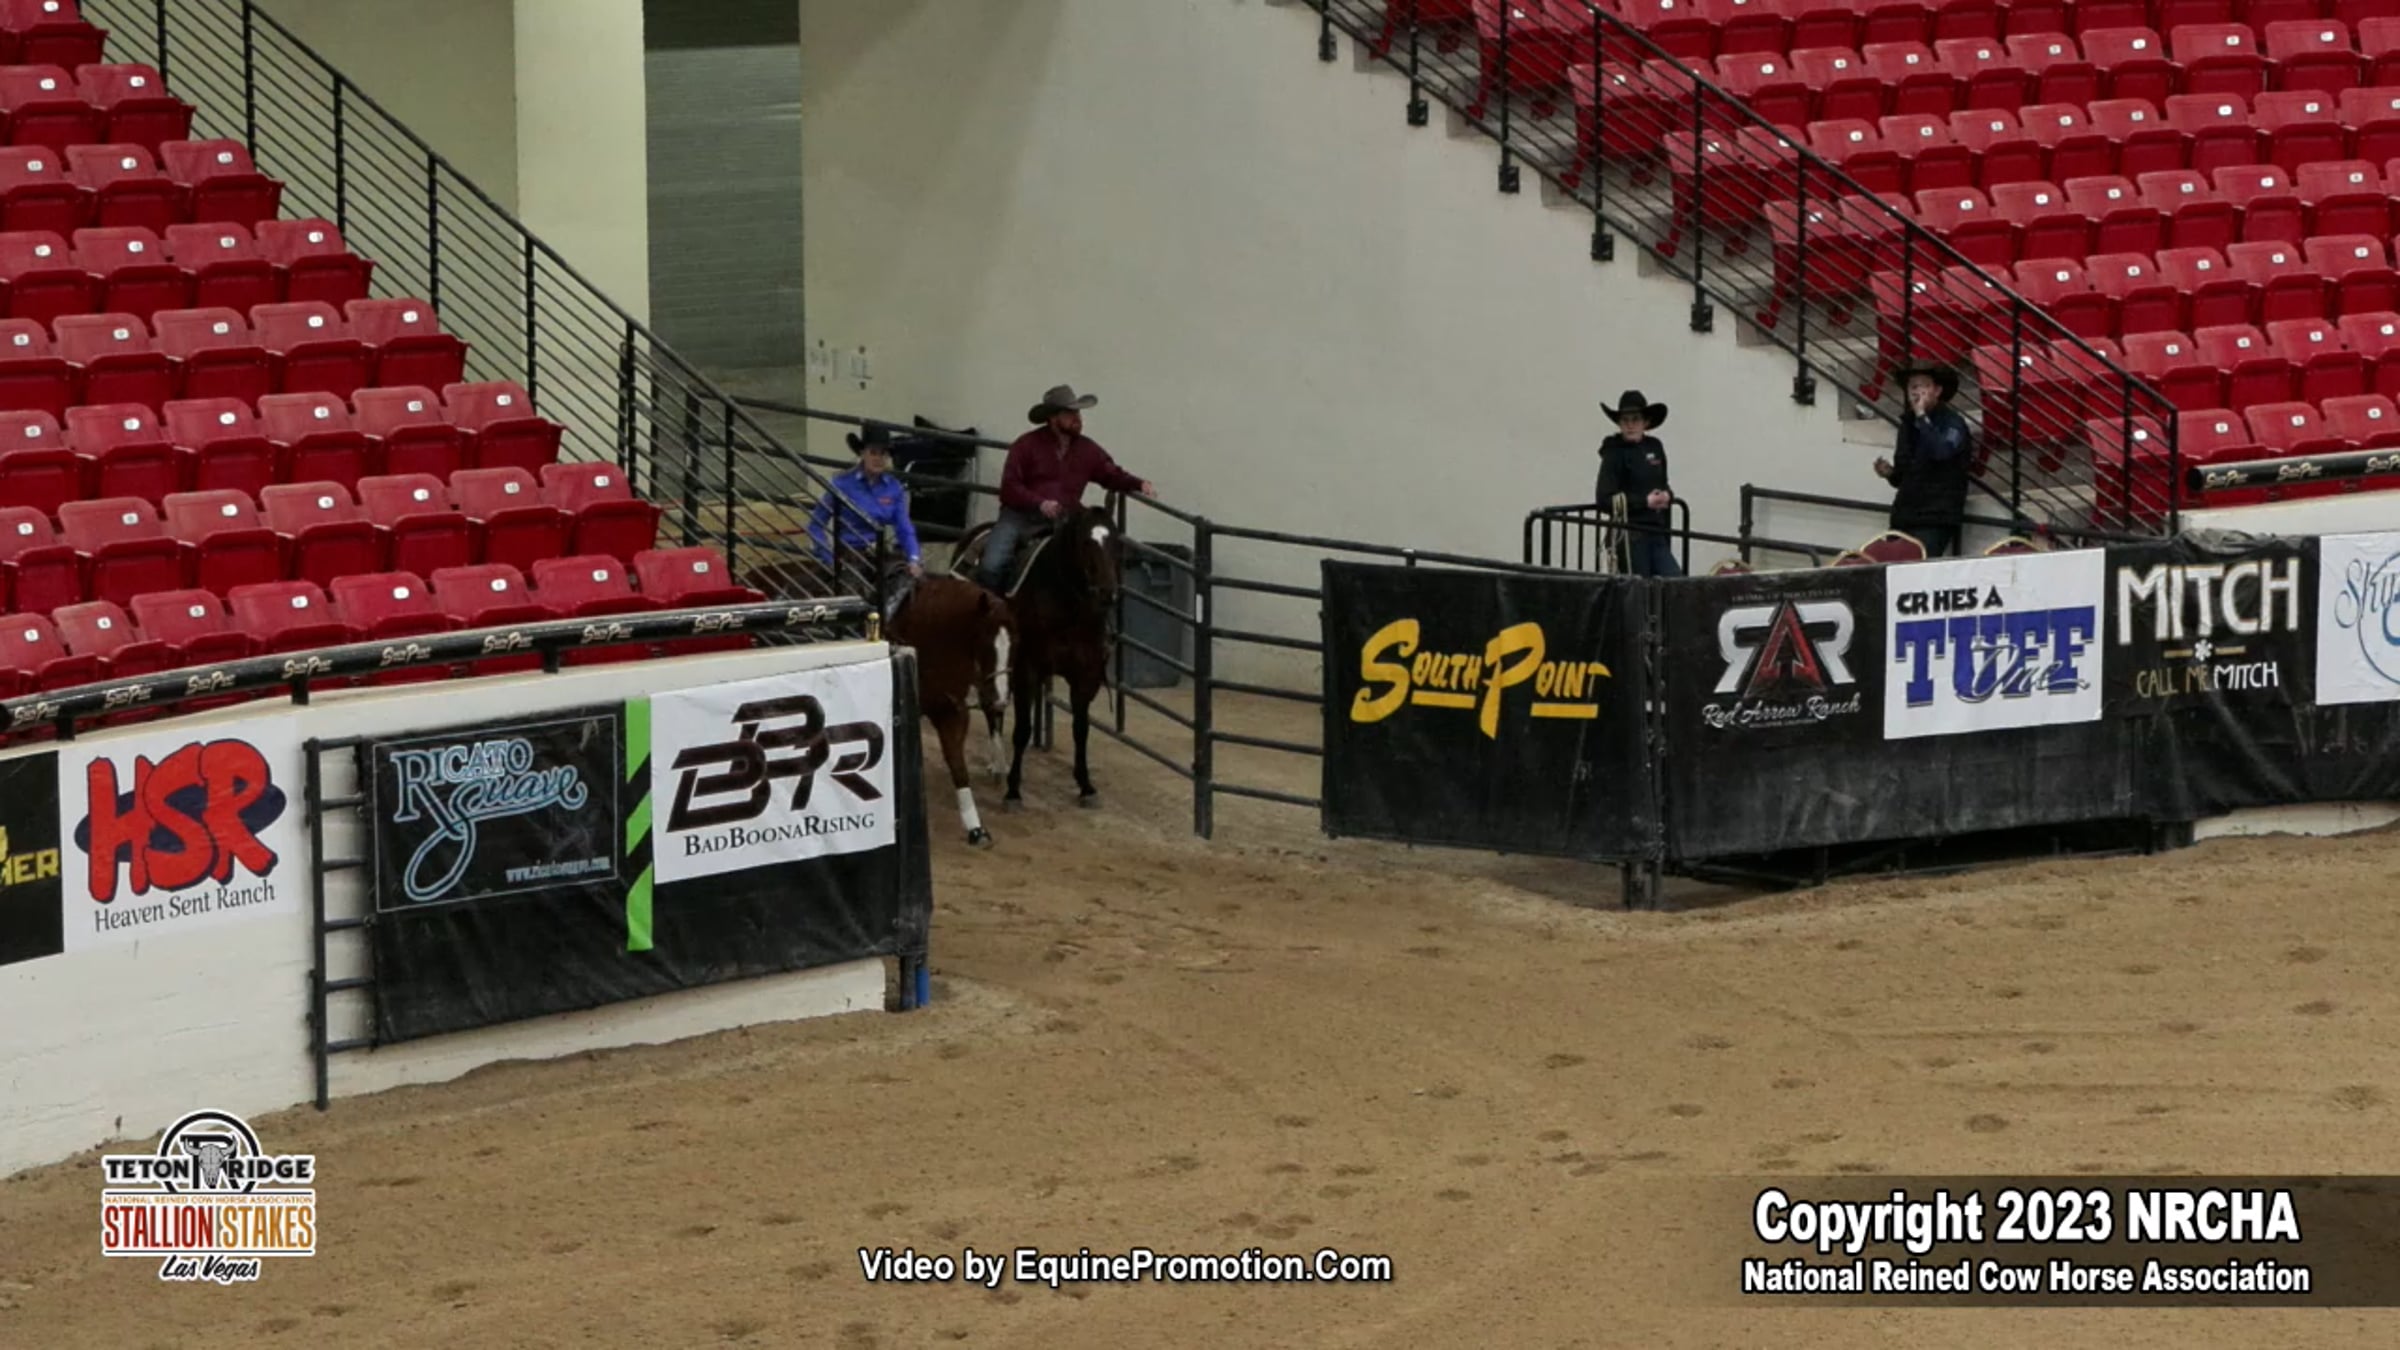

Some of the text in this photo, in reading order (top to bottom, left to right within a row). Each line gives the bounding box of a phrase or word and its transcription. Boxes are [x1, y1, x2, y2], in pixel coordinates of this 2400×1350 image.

[1896, 584, 2004, 615] CR HES A
[2118, 557, 2299, 645] MITCH
[1895, 605, 2095, 708] TUFF
[1970, 638, 2090, 698] One
[2136, 661, 2279, 698] CALL ME MITCH
[1702, 701, 1740, 728] Red
[1806, 691, 1861, 720] Ranch
[87, 739, 278, 903] HSR
[94, 878, 276, 932] Heaven Sent Ranch
